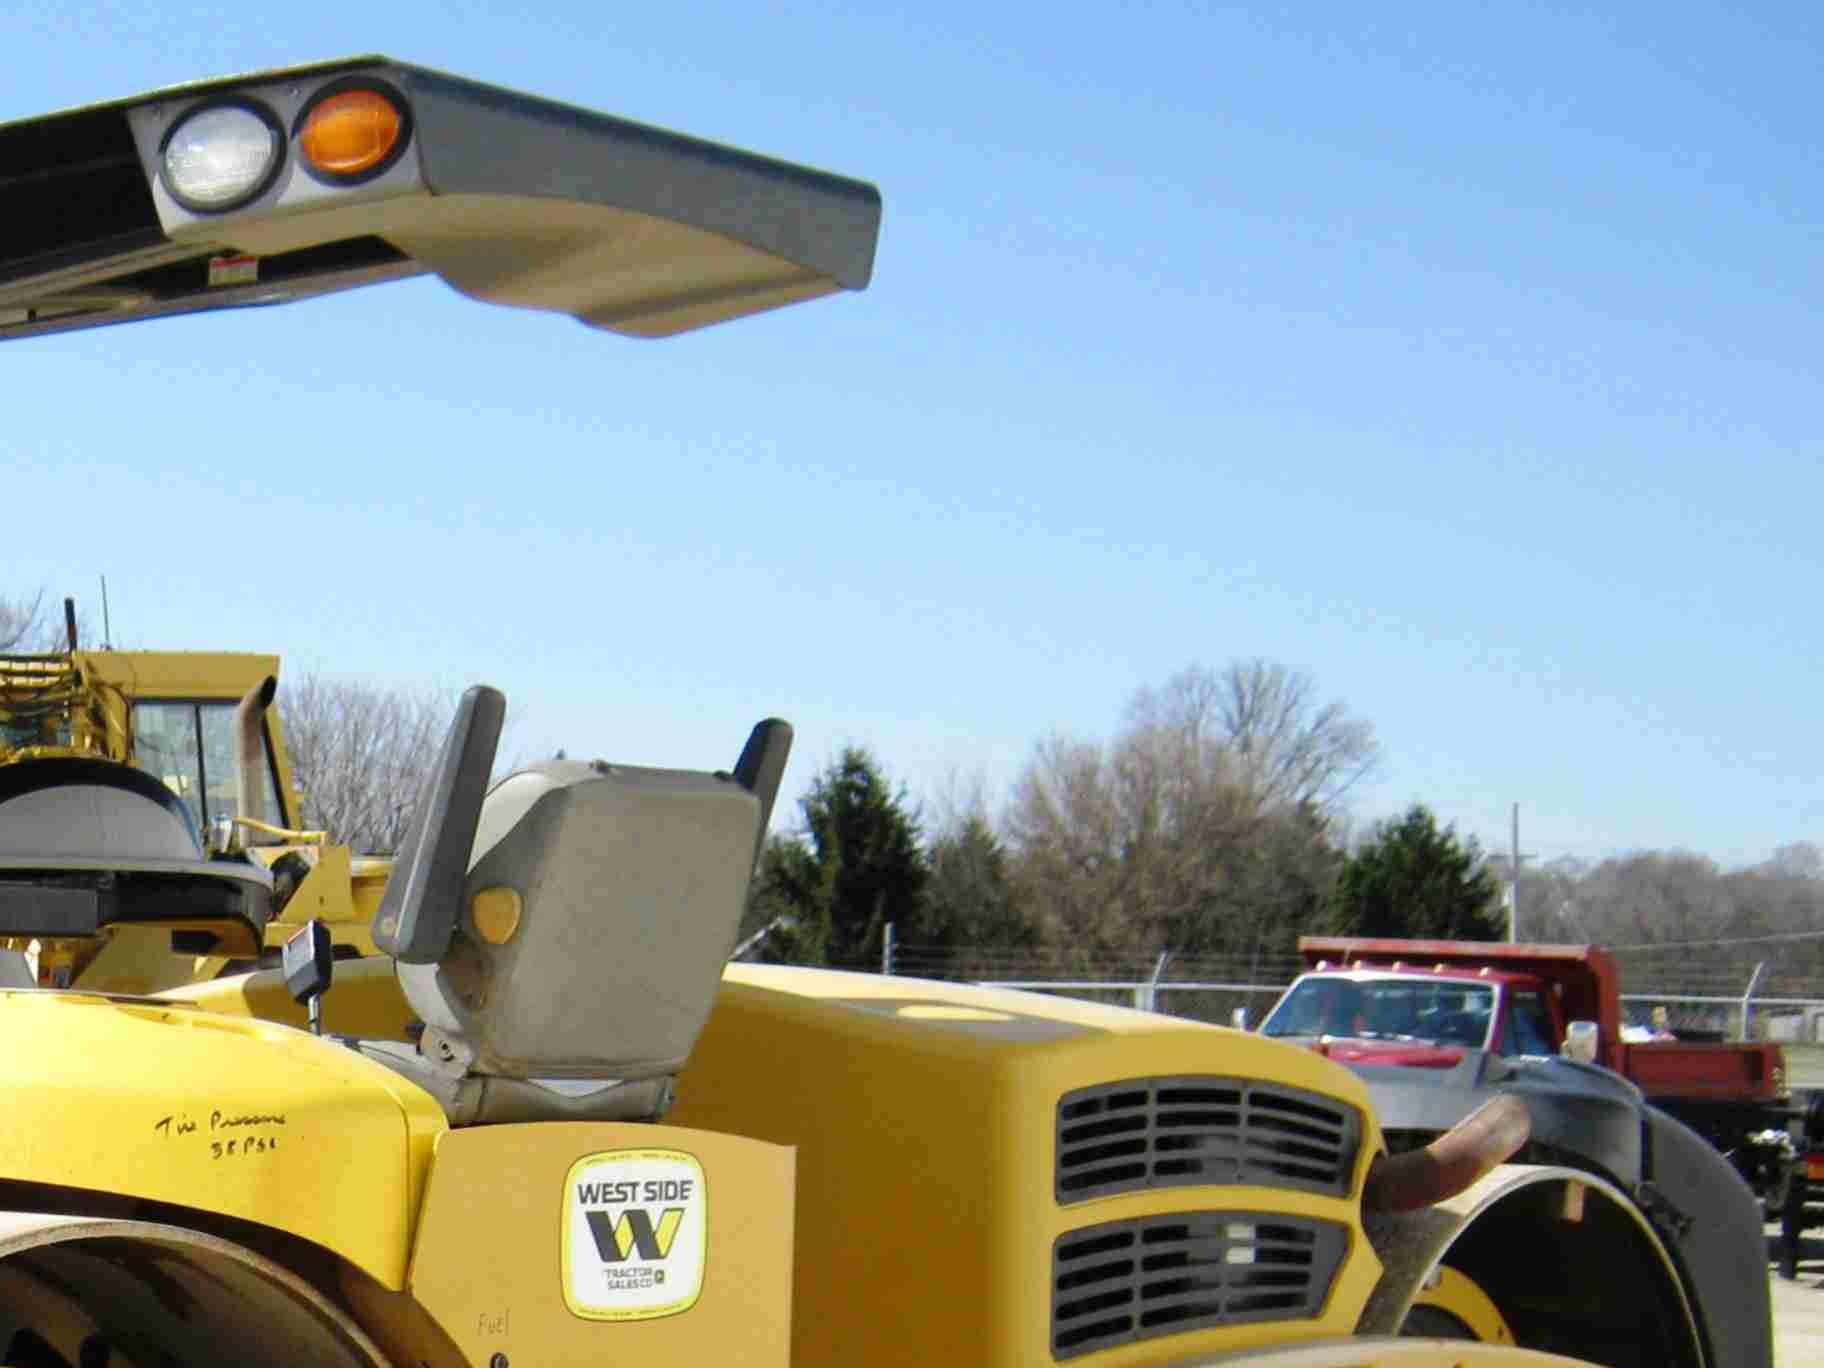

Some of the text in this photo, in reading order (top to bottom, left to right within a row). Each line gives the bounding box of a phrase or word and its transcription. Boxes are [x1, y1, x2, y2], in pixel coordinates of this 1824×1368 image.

[577, 1179, 694, 1205] WEST SIDE
[603, 1267, 653, 1279] TRACTOR
[607, 1279, 640, 1291] SALES
